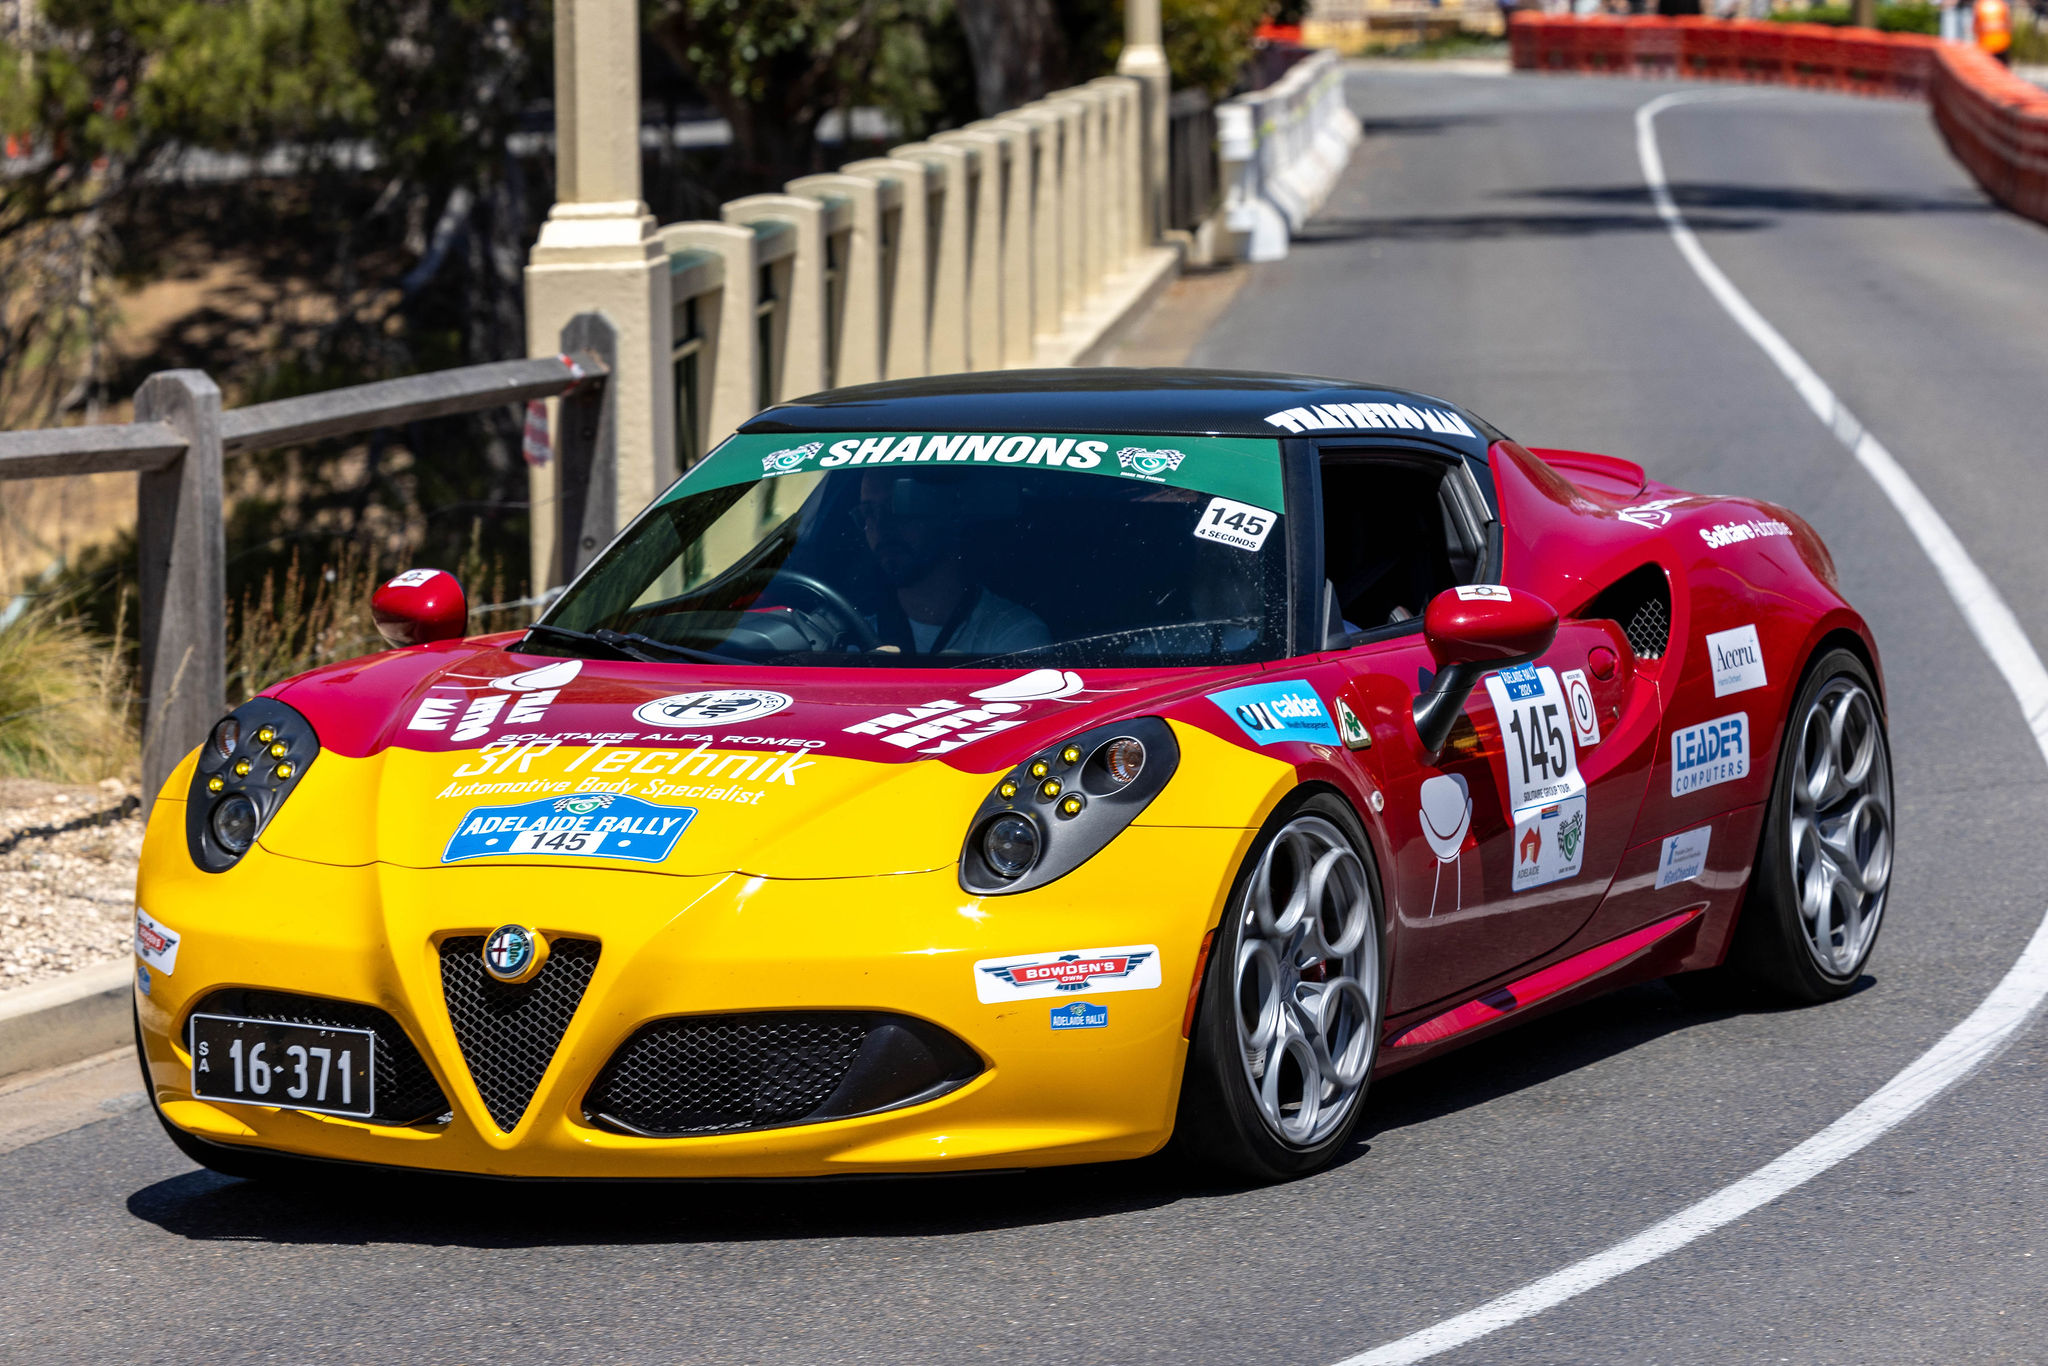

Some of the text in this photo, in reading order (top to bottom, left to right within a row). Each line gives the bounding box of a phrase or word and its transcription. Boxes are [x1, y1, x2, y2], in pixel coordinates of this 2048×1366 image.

[820, 435, 1108, 469] SHANNONS
[1211, 507, 1267, 536] 145
[1699, 521, 1756, 549] Solitaire
[1208, 530, 1257, 549] SECONDS
[1716, 643, 1755, 673] Accru
[1271, 693, 1322, 718] calder
[497, 732, 827, 749] SOLITAIRE ALFA ROMEO
[1510, 704, 1568, 785] 145
[1676, 719, 1743, 772] LEADER
[452, 739, 817, 786] 3R Technik
[1676, 759, 1744, 793] COMPUTERS
[436, 776, 766, 805] Automotive Body Specialist
[461, 816, 682, 837] ADELAIDE RALLY
[530, 831, 591, 851] 145
[1025, 961, 1116, 980] BOWDEN'S
[1061, 974, 1084, 983] OWN
[1052, 1012, 1106, 1027] ADELAIDE RALLY
